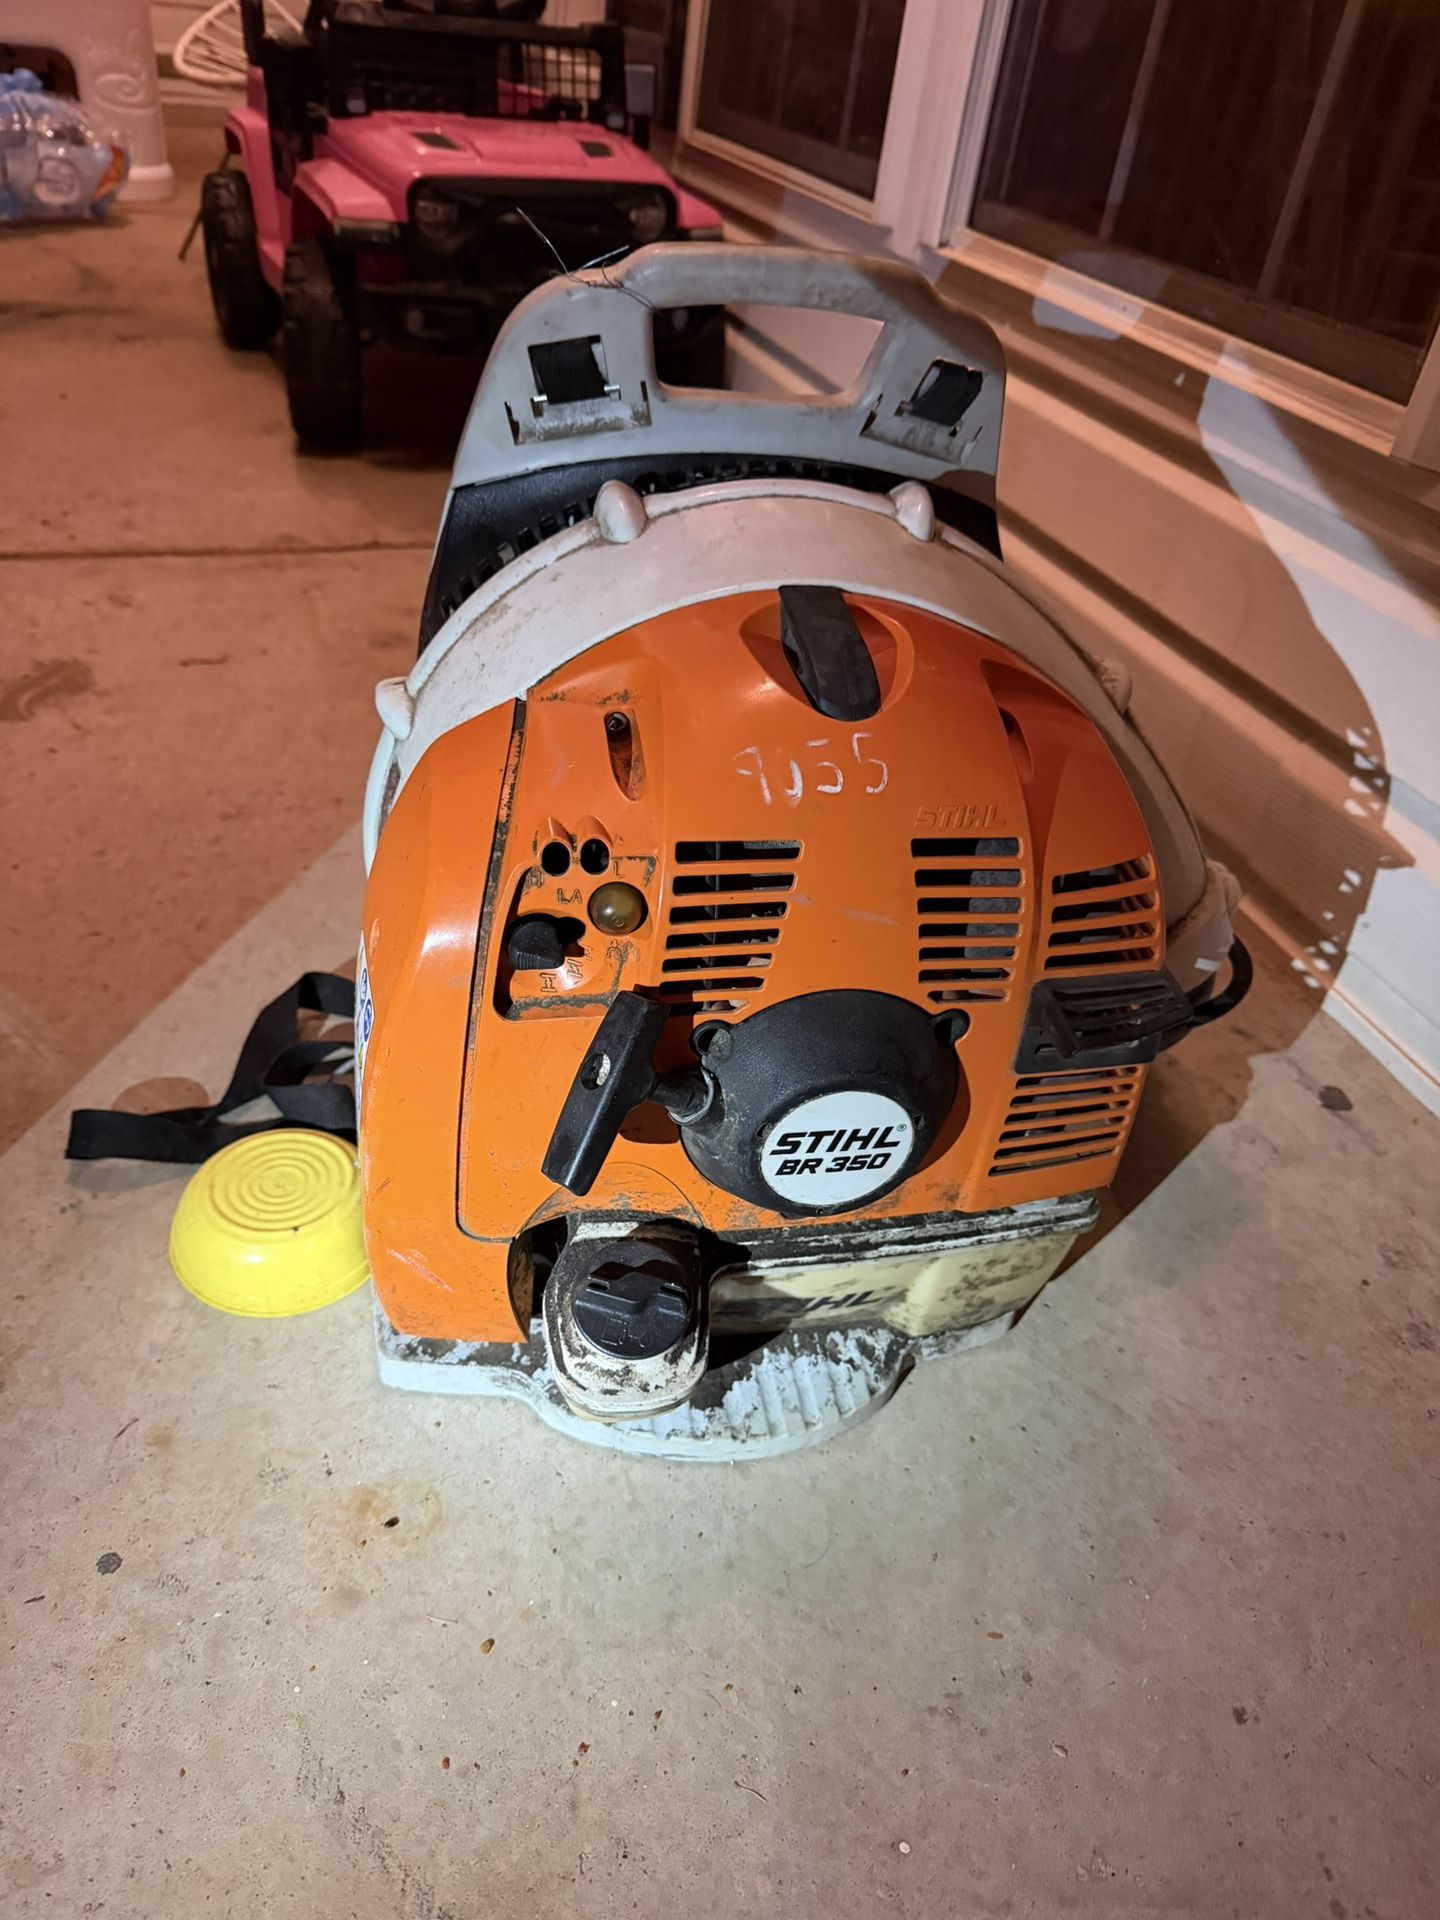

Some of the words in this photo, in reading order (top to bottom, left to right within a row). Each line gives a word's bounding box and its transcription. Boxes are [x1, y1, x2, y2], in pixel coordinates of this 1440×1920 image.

[912, 804, 1006, 829] STIHL
[556, 887, 583, 905] LA
[769, 1125, 901, 1156] STIHL
[774, 1157, 824, 1176] BR
[825, 1152, 892, 1173] 350
